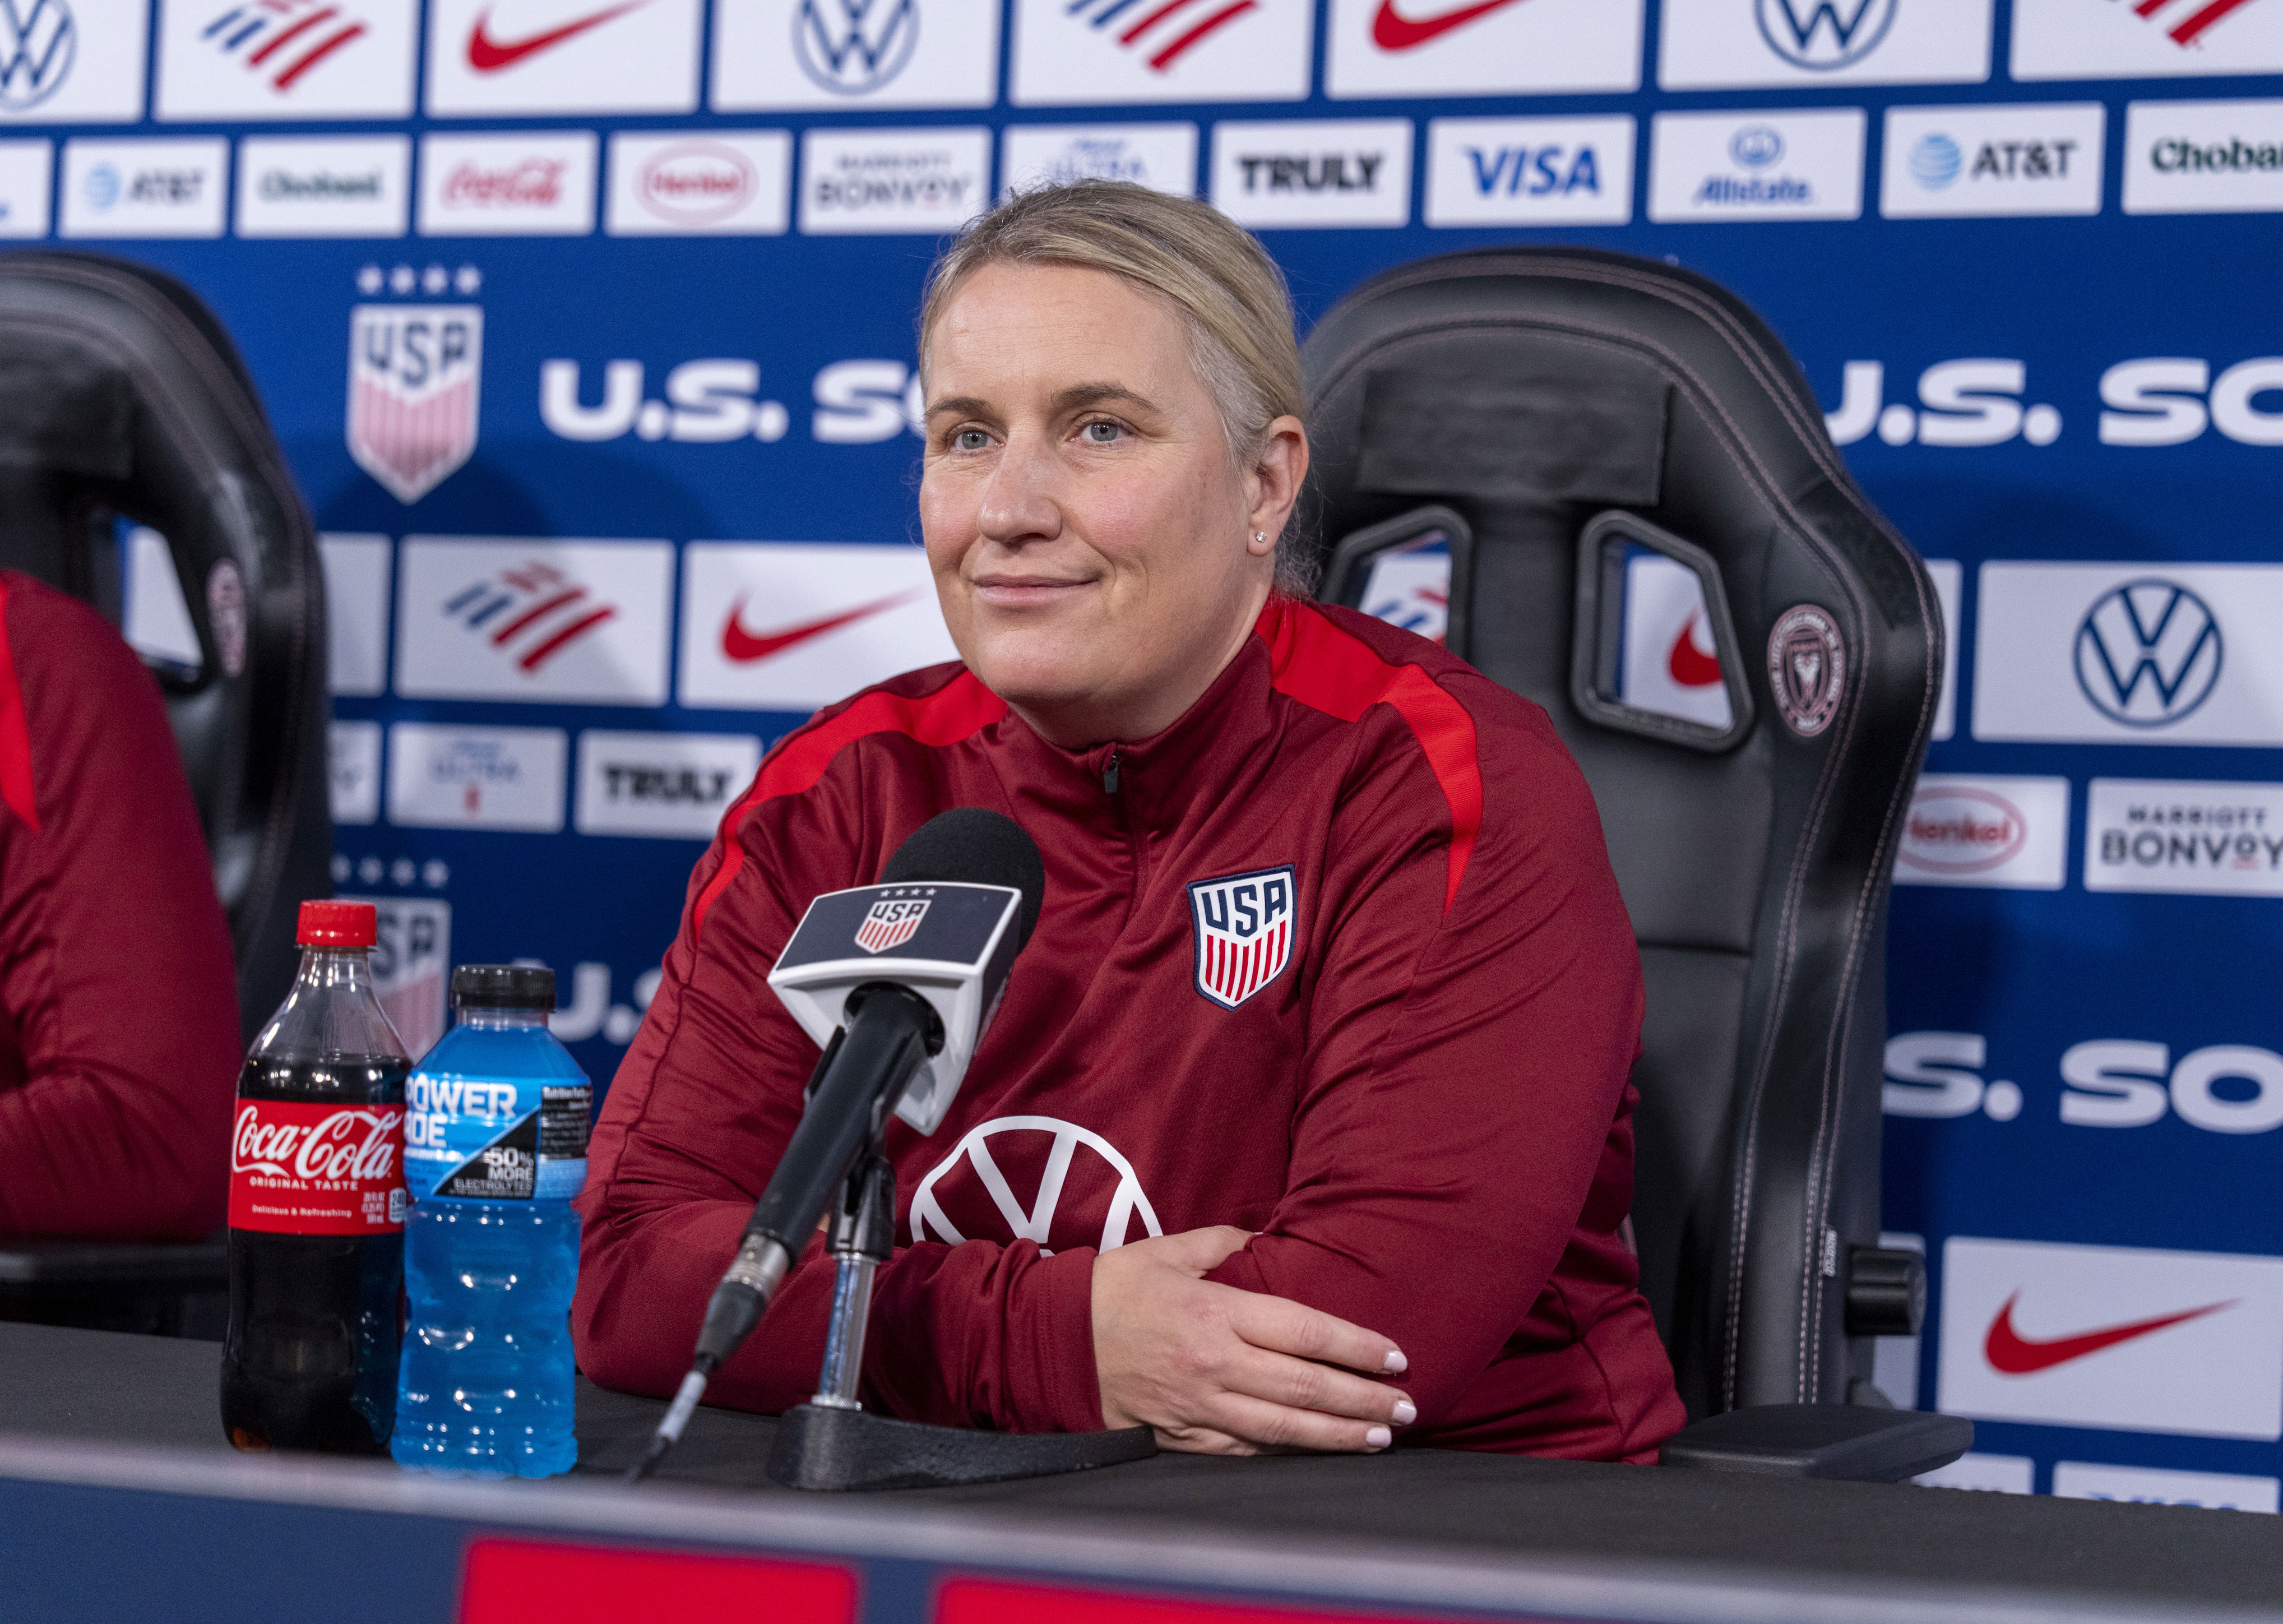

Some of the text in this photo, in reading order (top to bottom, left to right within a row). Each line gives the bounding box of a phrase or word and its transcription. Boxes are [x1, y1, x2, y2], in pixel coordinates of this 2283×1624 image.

[1239, 151, 1383, 193] TRULY
[1464, 143, 1601, 197] VISA
[1971, 140, 2076, 179] AT&T
[2150, 136, 2283, 174] Choba
[364, 321, 466, 388] USA
[539, 358, 789, 443] U.S.
[604, 762, 732, 806] TRULY
[2127, 805, 2266, 828] MARRIOTT
[2101, 829, 2283, 869] BONVOY
[872, 903, 925, 922] USA
[1201, 878, 1286, 937] USA
[232, 1105, 404, 1180] Coca-Cola
[249, 1176, 359, 1191] ORIGINAL TASTE
[453, 1178, 532, 1192] ELECTROLYTES
[488, 1168, 533, 1181] MORE
[252, 1204, 352, 1219] Delicious & Refreshing
